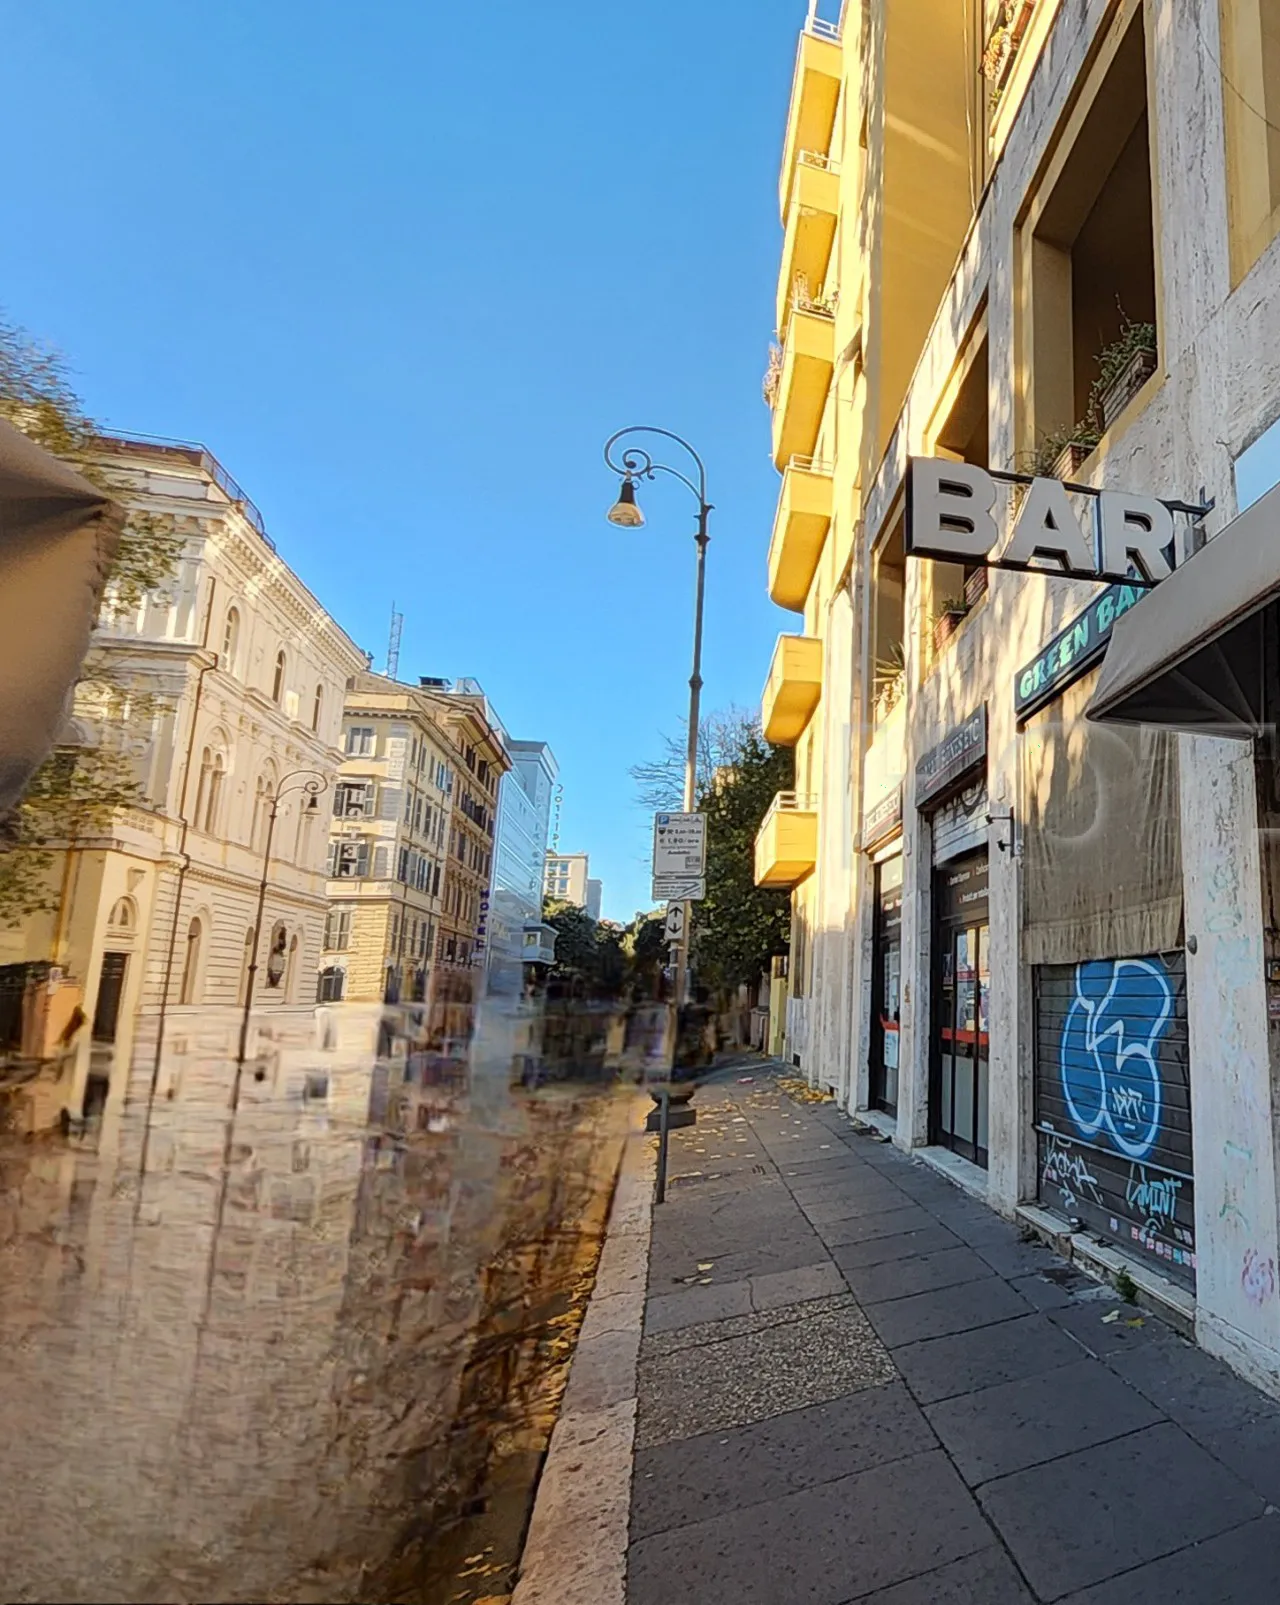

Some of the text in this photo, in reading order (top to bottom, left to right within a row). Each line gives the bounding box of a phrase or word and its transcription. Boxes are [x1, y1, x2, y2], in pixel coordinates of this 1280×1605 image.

[912, 458, 1176, 581] BAR
[1020, 615, 1089, 699] GREEN
[475, 889, 490, 950] HOTEL
